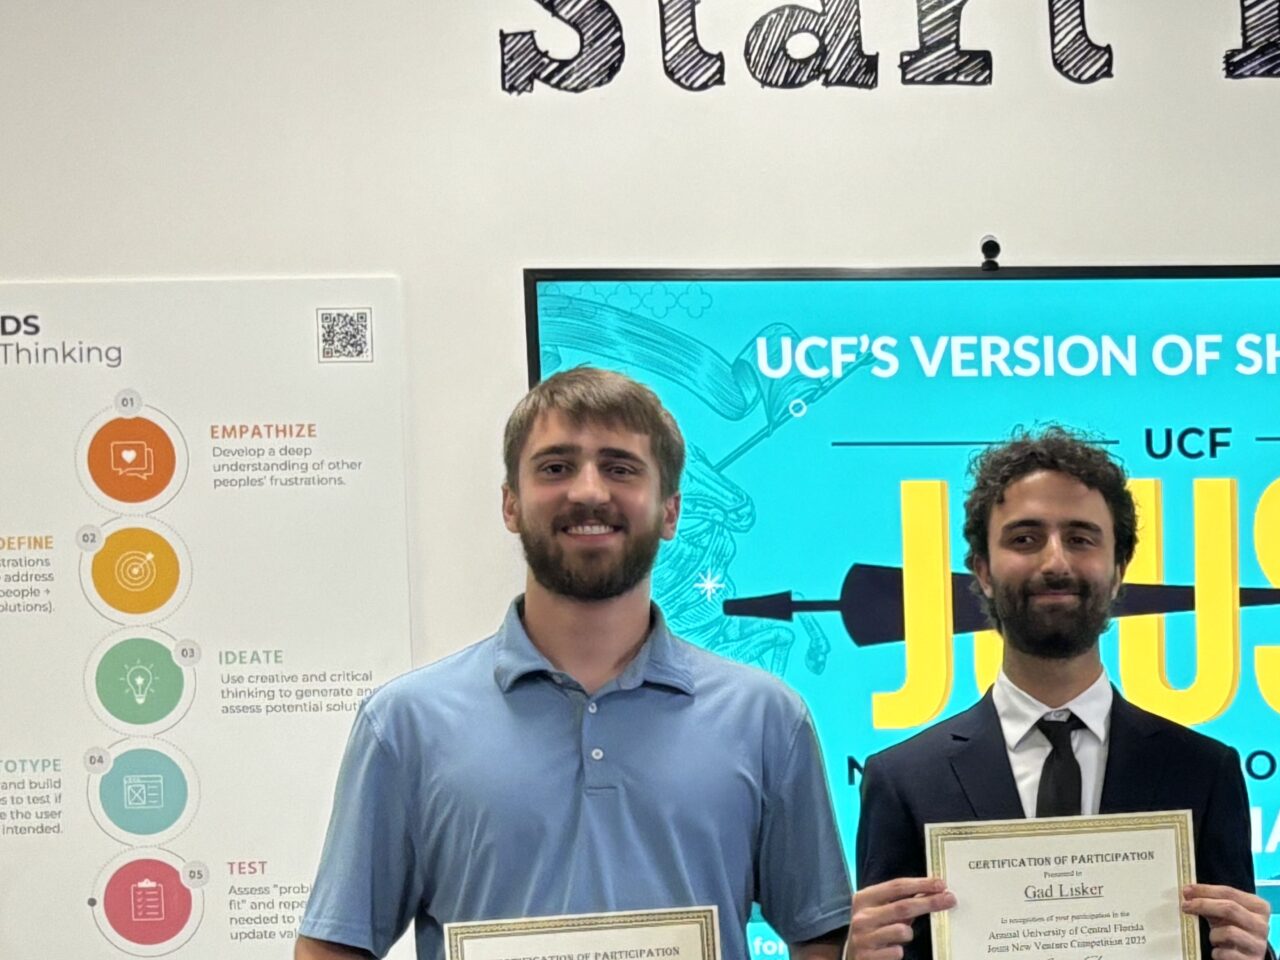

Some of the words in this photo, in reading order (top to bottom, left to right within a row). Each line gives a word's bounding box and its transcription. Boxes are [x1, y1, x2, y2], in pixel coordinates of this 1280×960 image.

[1, 315, 40, 335] DS
[0, 341, 122, 368] Thinking
[910, 335, 1136, 378] VERSION
[1152, 334, 1222, 376] OF
[121, 397, 135, 407] 01
[210, 424, 317, 439] EMPATHIZE
[1145, 427, 1232, 459] UCF
[212, 446, 265, 458] Develop
[268, 448, 275, 456] a
[279, 445, 312, 458] deep
[213, 460, 308, 473] understanding
[312, 459, 325, 471] of
[328, 459, 362, 470] other
[270, 475, 346, 487] frustrations.
[82, 533, 96, 543] 02
[4, 571, 55, 582] address
[181, 648, 195, 658] 03
[219, 650, 283, 665] IDEATE
[221, 673, 244, 684] Use
[248, 672, 298, 683] creative
[302, 672, 327, 683] and
[330, 670, 372, 682] critical
[221, 688, 275, 700] thinking
[278, 689, 291, 698] to
[295, 687, 352, 700] generate
[221, 703, 262, 714] assess
[265, 701, 322, 715] potential
[89, 755, 104, 765] 04
[1, 779, 25, 790] and
[29, 778, 61, 789] build
[10, 796, 24, 805] to
[27, 795, 50, 804] test
[55, 793, 62, 803] if
[10, 810, 31, 820] the
[36, 810, 62, 819] user
[2, 823, 63, 835] intended.
[968, 857, 1051, 870] CERTIFICATION
[1055, 856, 1069, 864] OF
[1071, 851, 1155, 864] PARTICIPATION
[227, 861, 267, 875] TEST
[189, 870, 203, 879] 05
[229, 885, 270, 895] Assess
[1024, 884, 1054, 899] Gad
[1059, 882, 1104, 897] Lisker
[229, 899, 246, 910] fit"
[250, 899, 274, 910] and
[230, 914, 278, 925] needed
[282, 915, 295, 924] to
[230, 929, 276, 941] update
[1023, 927, 1067, 938] University
[1069, 926, 1079, 935] of
[1080, 925, 1112, 934] Central
[1114, 924, 1145, 932] Florida
[1012, 943, 1031, 951] New
[1034, 940, 1068, 950] Venture
[594, 947, 680, 960] PARTICIPATION
